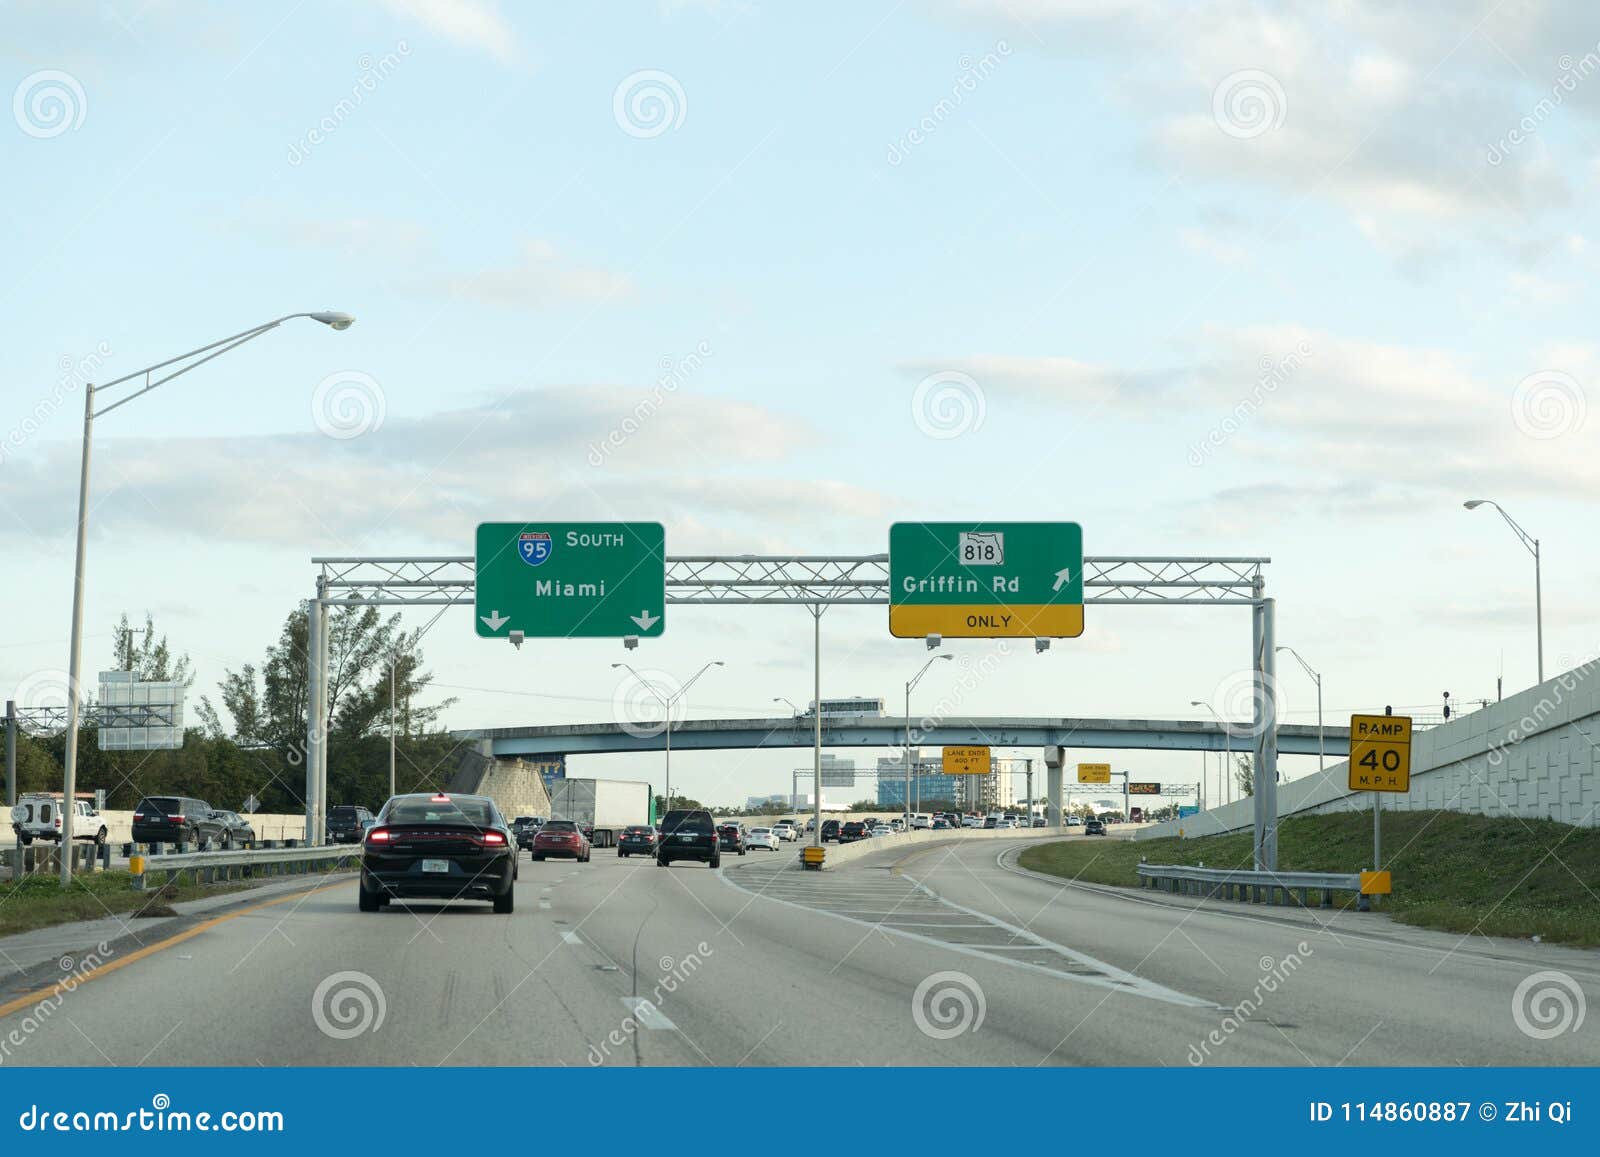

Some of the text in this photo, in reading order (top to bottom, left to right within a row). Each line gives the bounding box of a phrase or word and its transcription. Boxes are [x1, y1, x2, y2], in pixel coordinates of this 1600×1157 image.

[566, 531, 624, 547] SOUTH
[523, 542, 547, 559] 95
[964, 545, 995, 561] 818
[535, 580, 605, 597] Miami
[903, 576, 1020, 593] Griffin Rd
[967, 615, 1011, 628] ONLY
[1358, 722, 1403, 736] RAMP
[1358, 749, 1400, 772] 40
